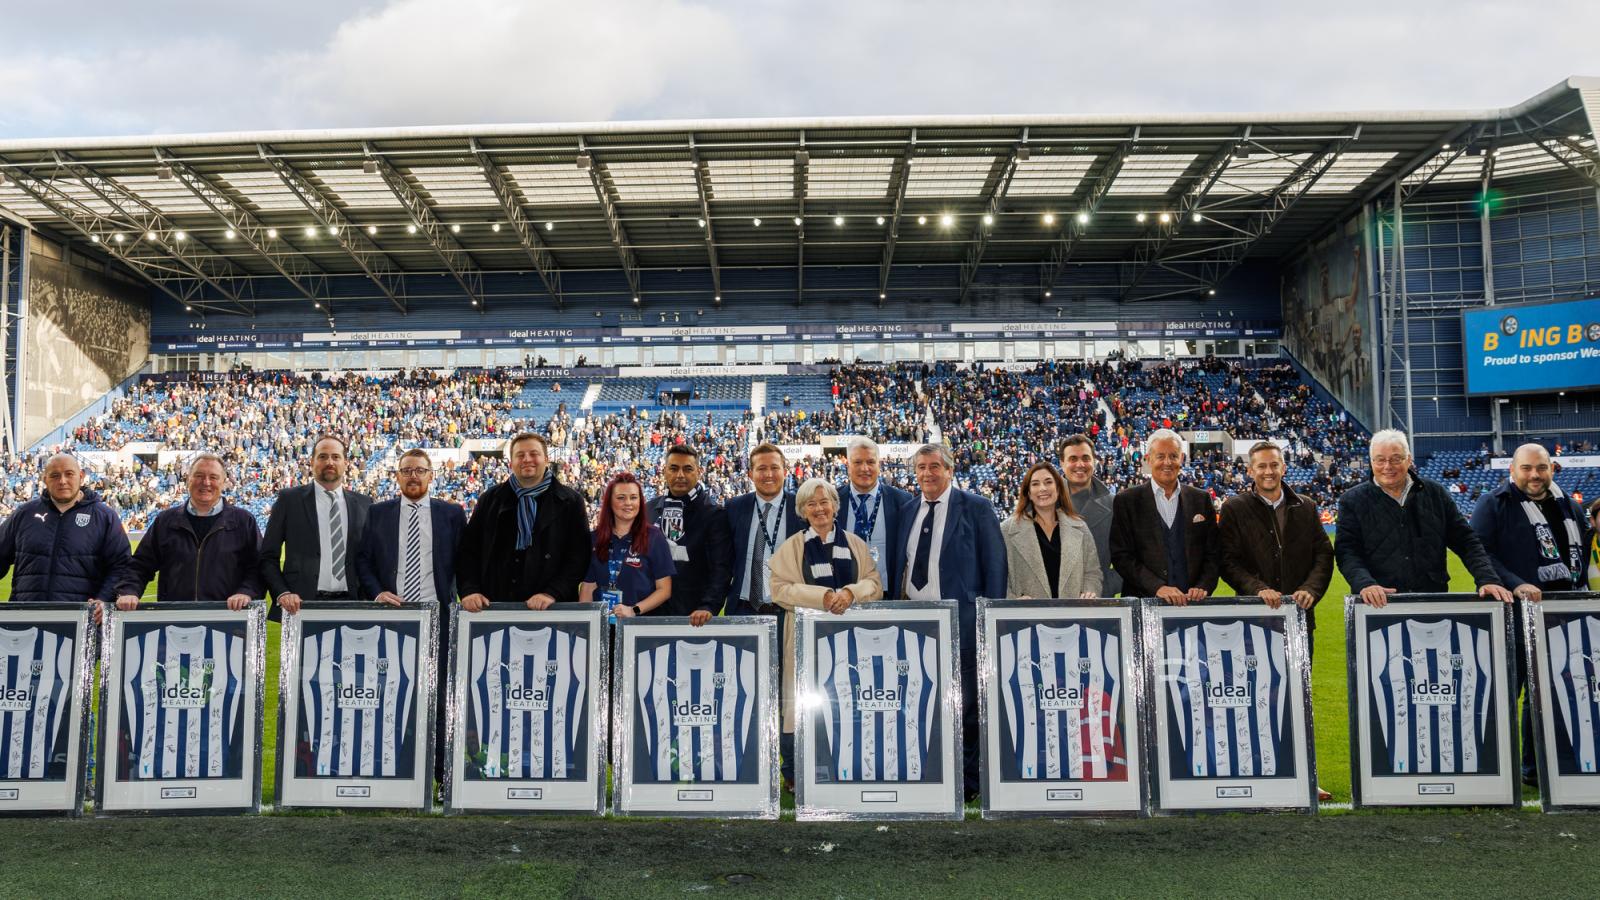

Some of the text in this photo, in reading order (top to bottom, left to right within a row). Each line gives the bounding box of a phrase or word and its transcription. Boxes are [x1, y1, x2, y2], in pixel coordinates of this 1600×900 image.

[836, 325, 856, 333] ideal
[1001, 323, 1022, 331] ideal
[1166, 321, 1231, 330] ideal HEATING
[350, 331, 413, 340] ideal HEATING
[509, 329, 573, 338] ideal HEATING
[671, 327, 691, 336] ideal
[196, 335, 215, 343] ideal
[1483, 347, 1600, 366] Proud to sponsor We
[526, 369, 570, 377] HEATING
[670, 367, 690, 376] ideal
[783, 445, 802, 454] ideal
[890, 445, 909, 453] ideal
[337, 682, 380, 700] ideal
[1038, 682, 1084, 700] ideal
[1206, 681, 1251, 698] ideal
[1410, 678, 1457, 695] ideal
[162, 683, 206, 700] ideal
[506, 684, 550, 701] ideal
[855, 684, 902, 701] ideal
[161, 699, 206, 707] HEATING
[1039, 699, 1084, 707] HEATING
[1207, 698, 1251, 706] HEATING
[1411, 695, 1457, 703] HEATING
[337, 700, 380, 708] HEATING
[506, 701, 548, 709] HEATING
[672, 698, 718, 715] ideal
[856, 701, 902, 709] HEATING
[673, 715, 717, 724] HEATING
